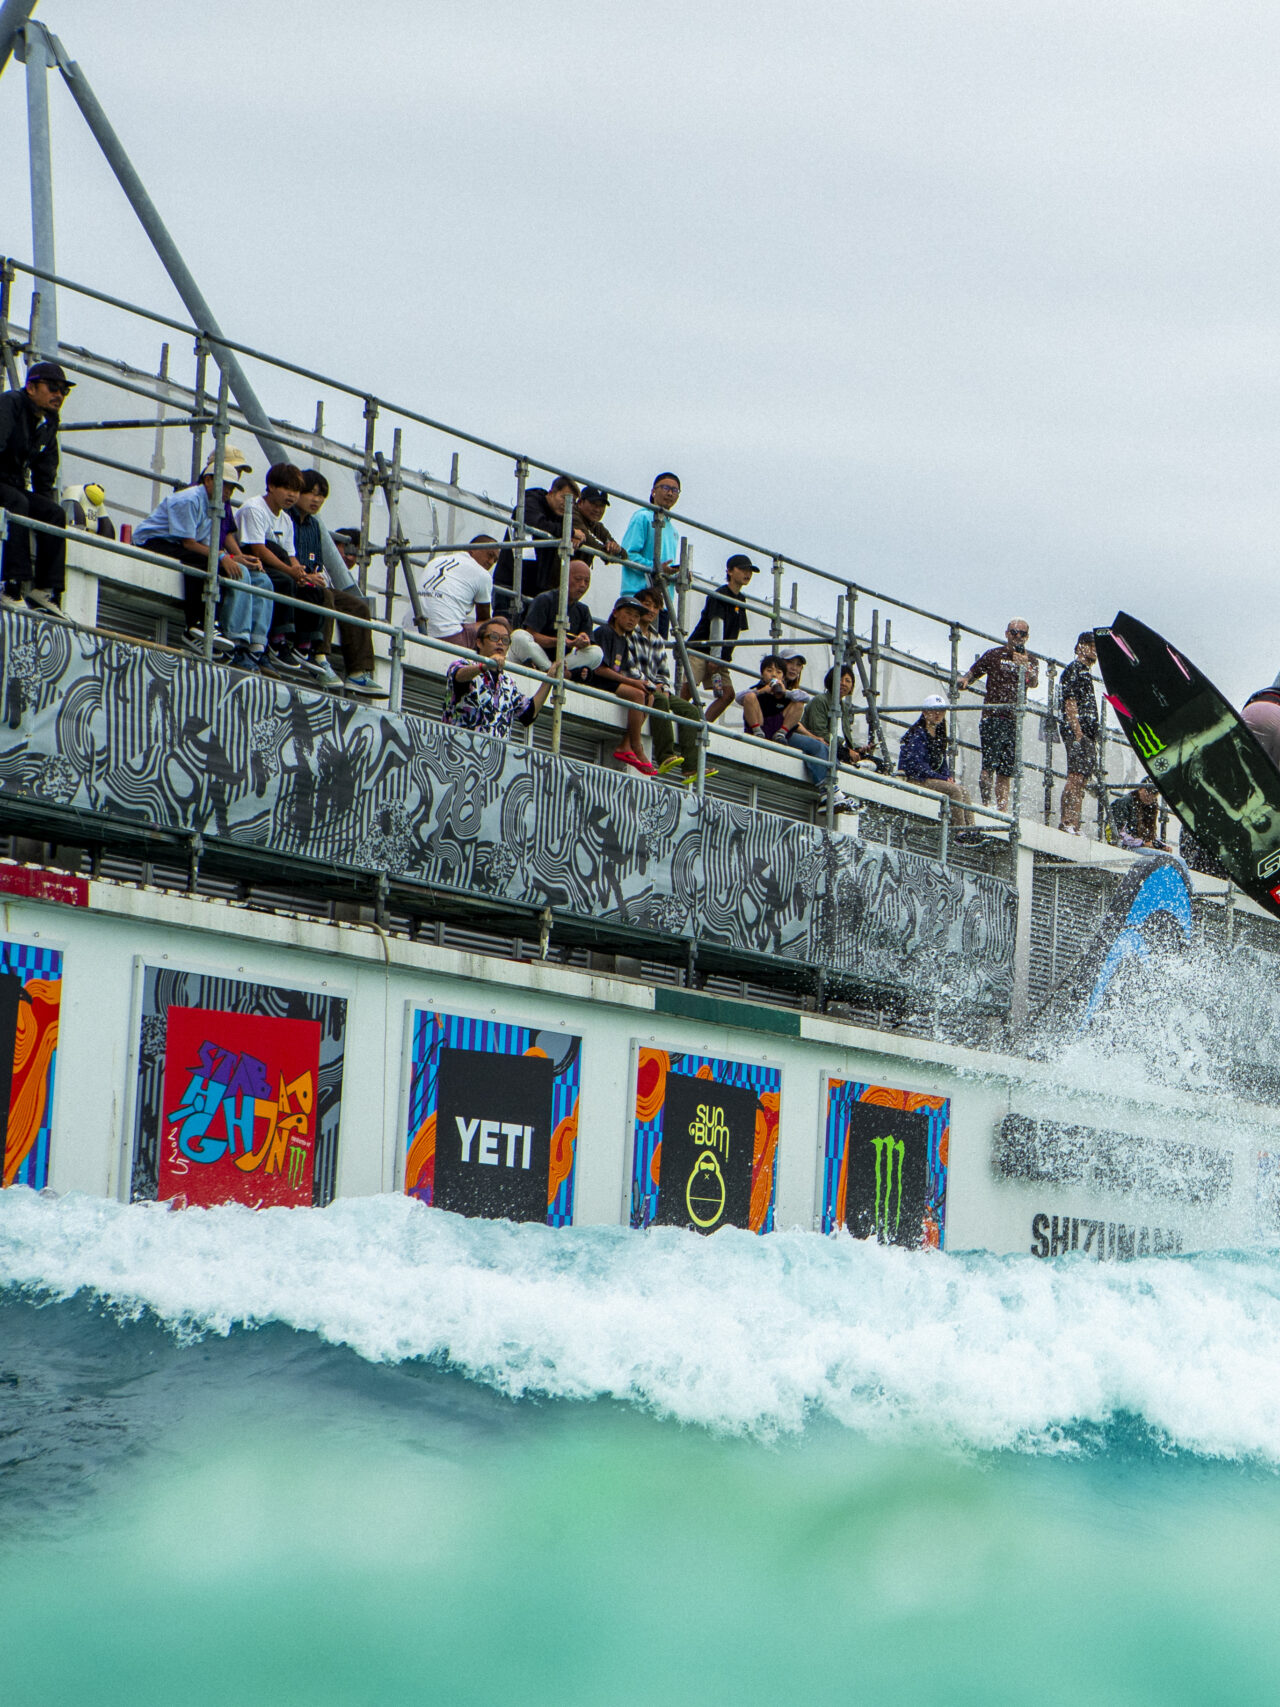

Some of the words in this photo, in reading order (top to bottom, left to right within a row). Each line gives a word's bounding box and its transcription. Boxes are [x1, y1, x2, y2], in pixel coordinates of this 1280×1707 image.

[185, 1039, 273, 1100] STAB
[167, 1126, 190, 1175] 2025
[455, 1116, 532, 1170] YETI
